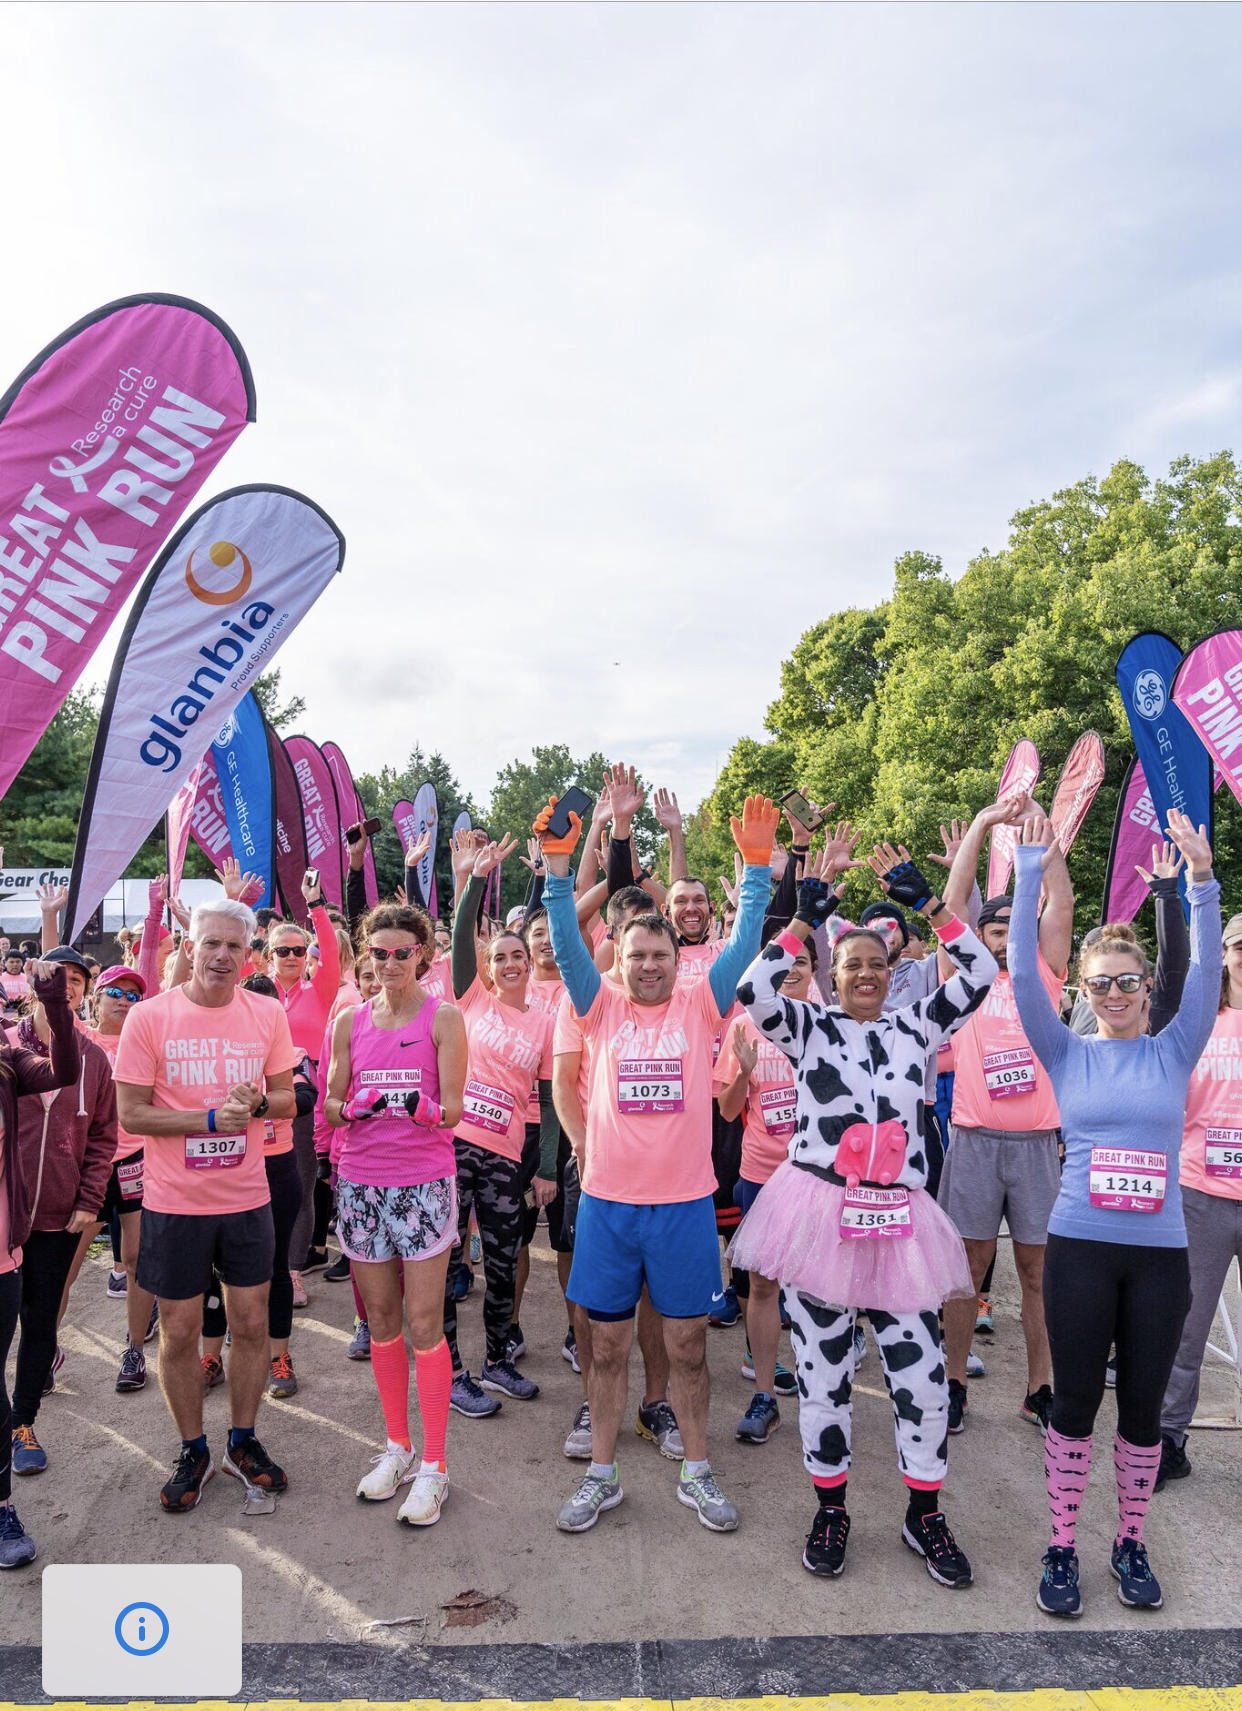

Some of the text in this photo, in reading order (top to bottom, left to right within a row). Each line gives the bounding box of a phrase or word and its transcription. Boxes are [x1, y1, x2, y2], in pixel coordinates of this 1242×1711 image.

[70, 366, 142, 457] Research
[112, 375, 157, 438] a cure
[1, 385, 226, 684] PINK RUN
[230, 612, 290, 691] Proud Supporters
[140, 601, 276, 773] glanbia
[1156, 727, 1188, 815] GE Health
[294, 758, 322, 806] GREAT
[226, 751, 256, 857] GE Healthcare
[191, 797, 232, 855] RUN
[39, 871, 69, 887] Che
[981, 995, 1011, 1020] INK
[165, 1038, 264, 1060] GREAT Research
[984, 1056, 1002, 1067] GREAT
[1003, 1053, 1019, 1063] PINK
[1020, 1050, 1031, 1059] RUN
[165, 1057, 264, 1086] PINK RUN
[362, 1071, 420, 1082] GREAT PINK RUN
[620, 1063, 680, 1073] GREAT PINK RUN
[995, 1069, 1029, 1085] 1036
[468, 1082, 488, 1094] GREAT
[489, 1087, 505, 1100] PINK
[631, 1084, 671, 1098] 1073
[762, 1089, 797, 1103] GREAT PIN
[204, 1096, 227, 1105] glanb
[471, 1102, 503, 1120] 1540
[1207, 1130, 1242, 1140] GREAT PI
[199, 1140, 236, 1154] 1307
[1093, 1152, 1165, 1168] GREAT PINK RUN
[119, 1166, 139, 1177] GREAT
[1106, 1177, 1153, 1194] 1214
[846, 1188, 907, 1202] GREAT PINK RUN
[855, 1213, 897, 1226] 1361
